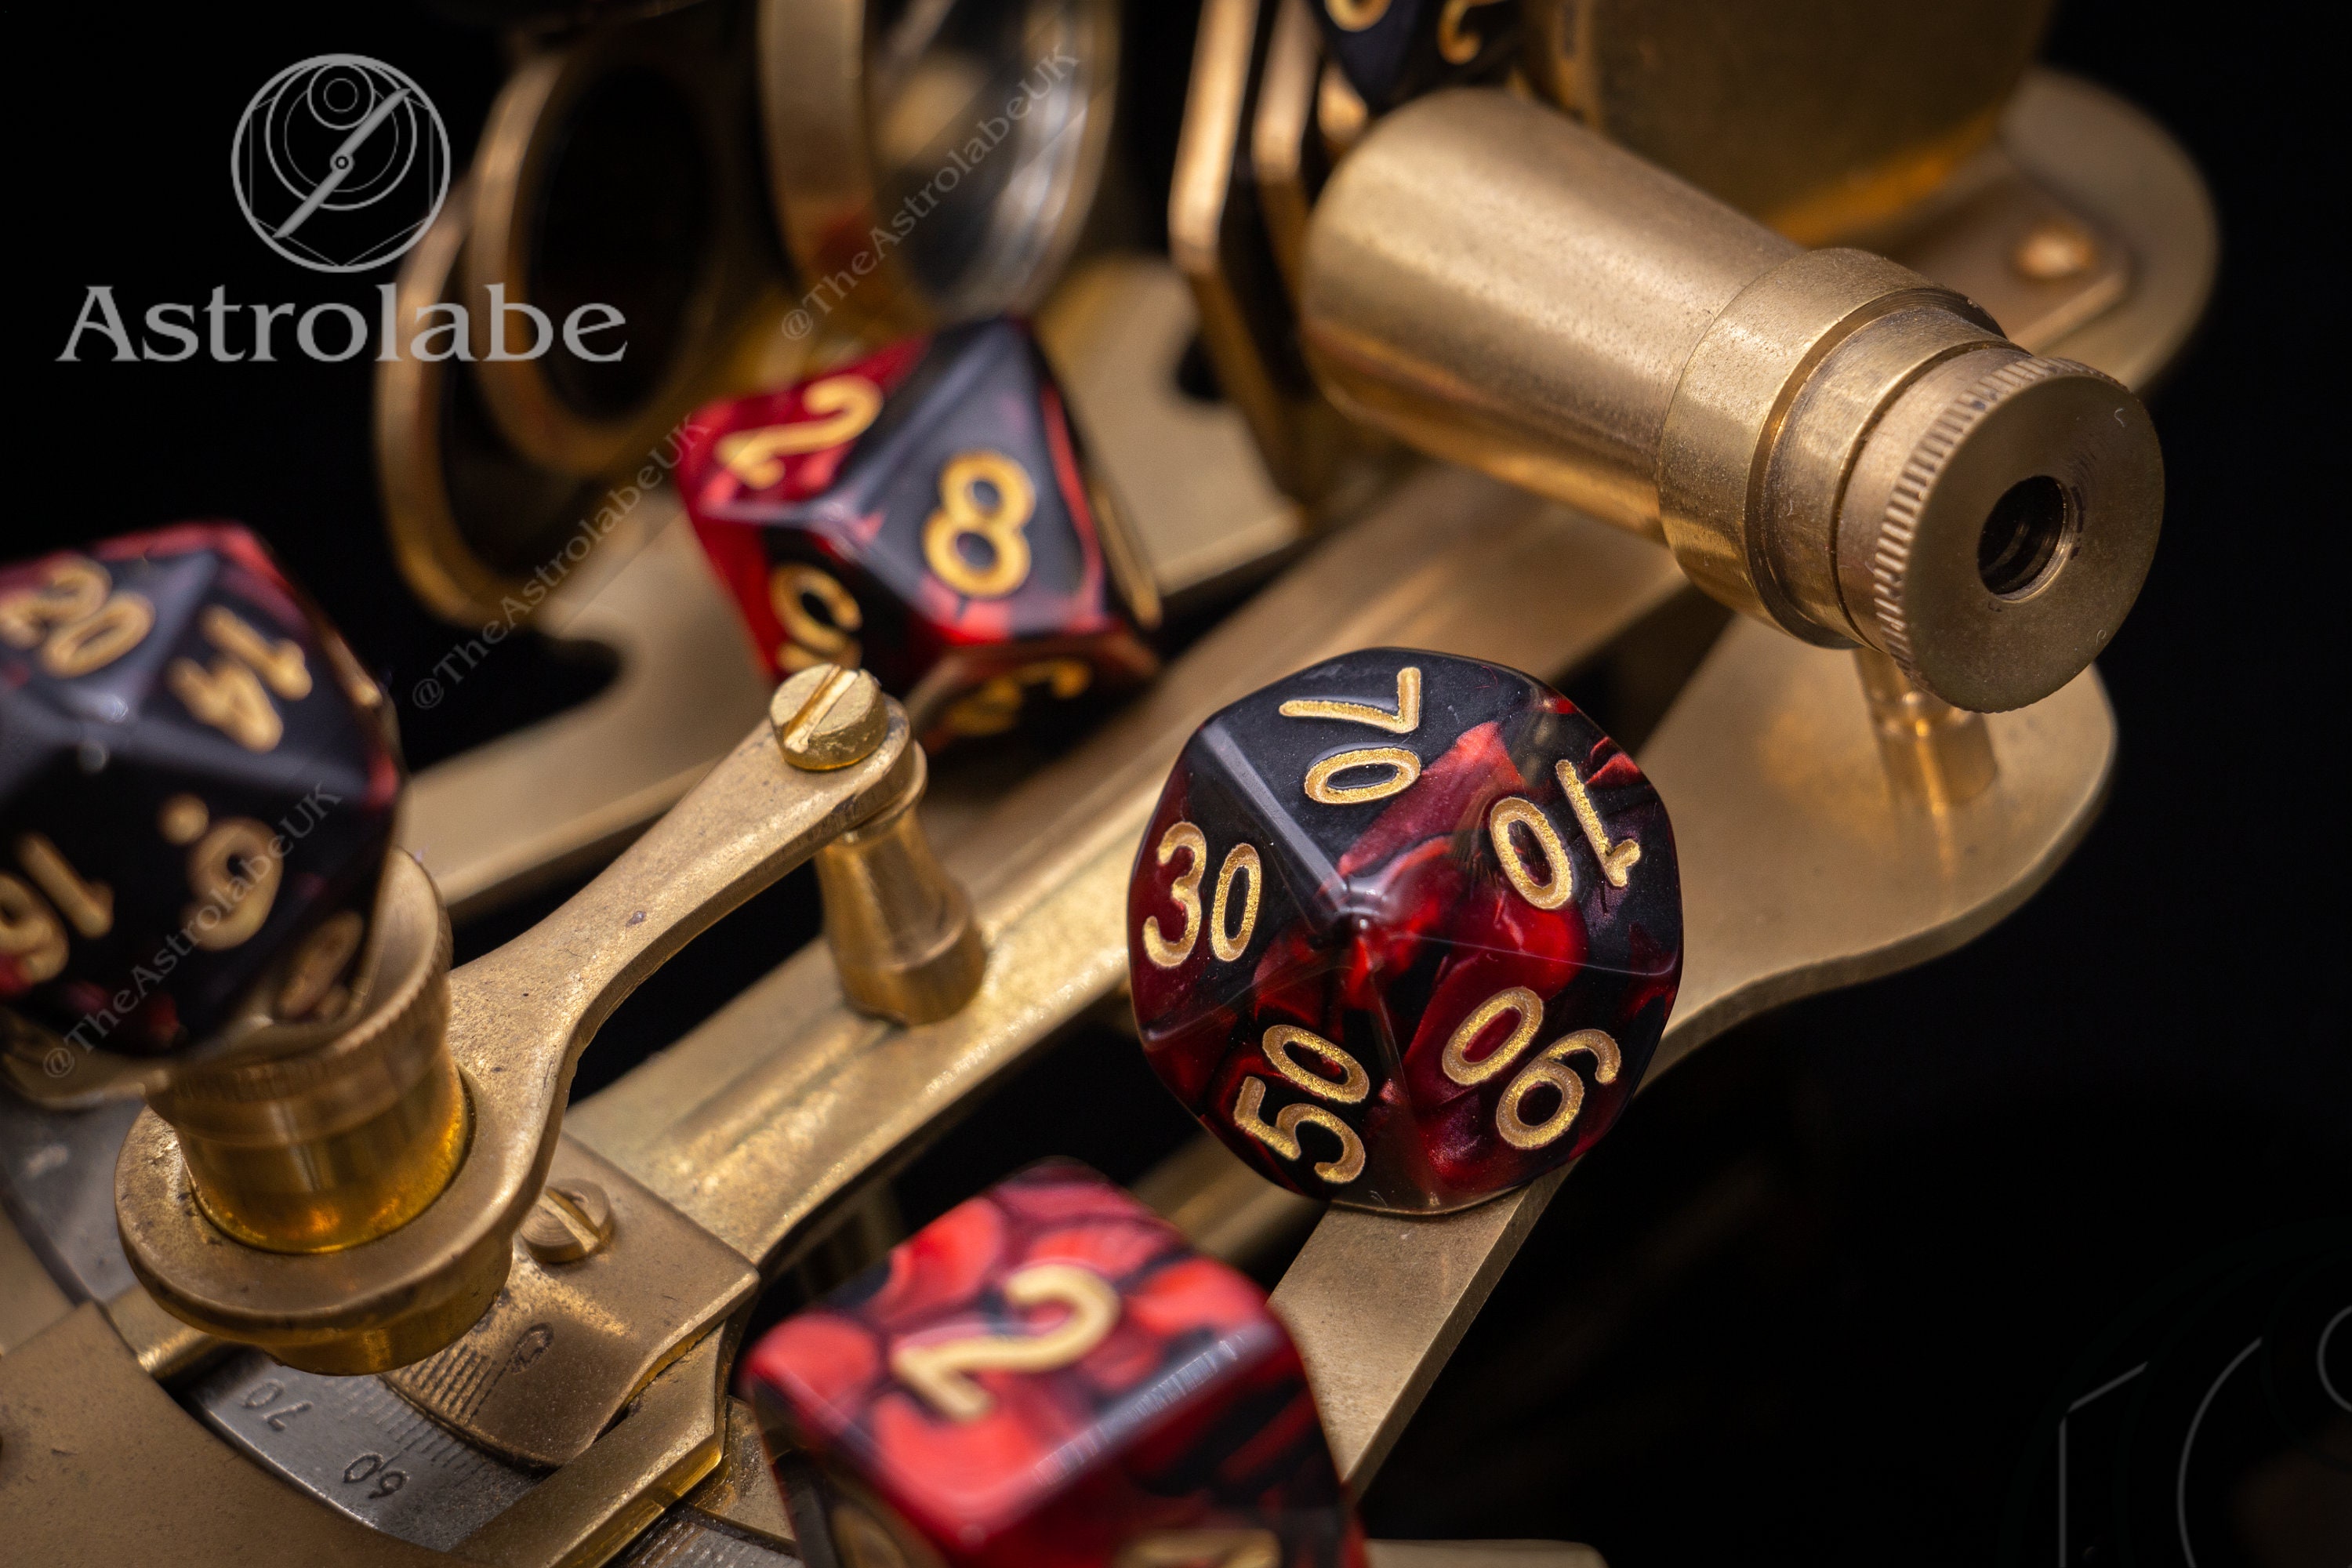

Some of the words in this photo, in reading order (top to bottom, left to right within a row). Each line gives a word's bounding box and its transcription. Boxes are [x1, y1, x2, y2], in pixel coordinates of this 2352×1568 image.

[714, 375, 884, 488] 2
[923, 450, 1036, 598] 8
[1279, 666, 1421, 804] 70
[1142, 821, 1261, 967] 30
[1490, 758, 1641, 910] 10
[1234, 1024, 1369, 1184] 50
[243, 1378, 313, 1431] 70
[889, 1264, 1120, 1425] 2
